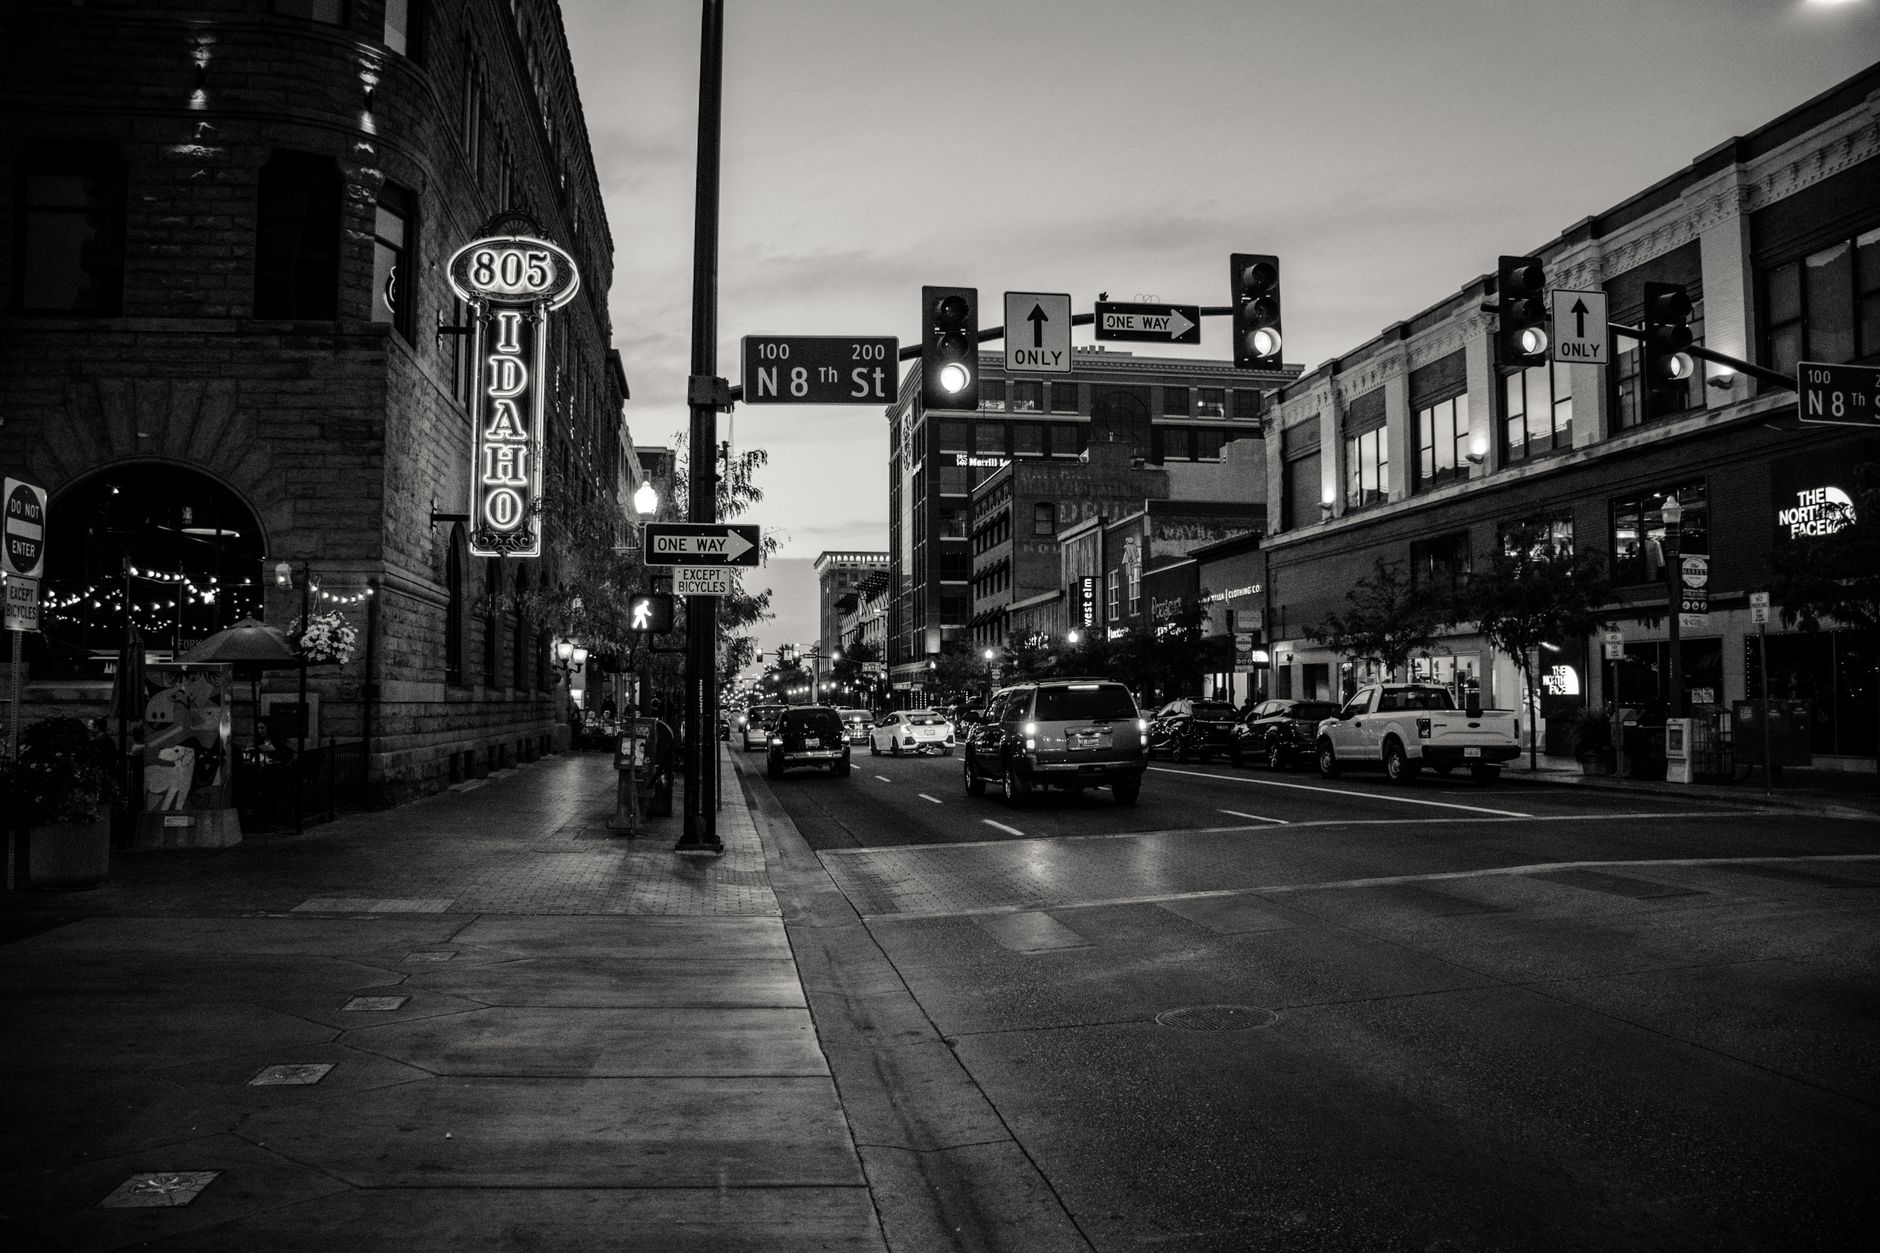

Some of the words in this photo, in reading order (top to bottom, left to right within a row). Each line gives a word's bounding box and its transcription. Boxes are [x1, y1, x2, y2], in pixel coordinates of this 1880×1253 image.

[473, 250, 550, 288] 805
[1107, 316, 1134, 329] ONE
[1143, 317, 1170, 330] WAY
[758, 343, 790, 359] 100
[852, 344, 885, 360] 200
[1015, 349, 1062, 366] ONLY
[1562, 342, 1600, 357] ONLY
[758, 366, 777, 396] N
[790, 367, 809, 397] 8
[818, 366, 838, 383] Th
[851, 367, 885, 397] St
[1808, 370, 1831, 384] 100
[1808, 389, 1823, 415] N
[1832, 391, 1845, 417] 8
[483, 311, 528, 530] IDAHO
[969, 458, 998, 467] Merrill
[1797, 488, 1825, 506] THE
[11, 499, 22, 514] DO
[25, 505, 40, 519] NOT
[1791, 520, 1826, 539] FACE
[12, 540, 36, 558] ENTER
[658, 538, 687, 551] ONE
[697, 538, 726, 552] WAY
[683, 569, 721, 580] EXCEPT
[10, 586, 34, 602] EXCEPT
[678, 581, 725, 592] BICYCLES
[1082, 578, 1093, 599] elm
[1228, 586, 1251, 598] CLOTHING
[7, 604, 37, 621] BICYCLES
[1083, 601, 1093, 627] west
[177, 639, 202, 650] FORK
[1552, 665, 1566, 676] THE
[1542, 675, 1566, 686] NORTH
